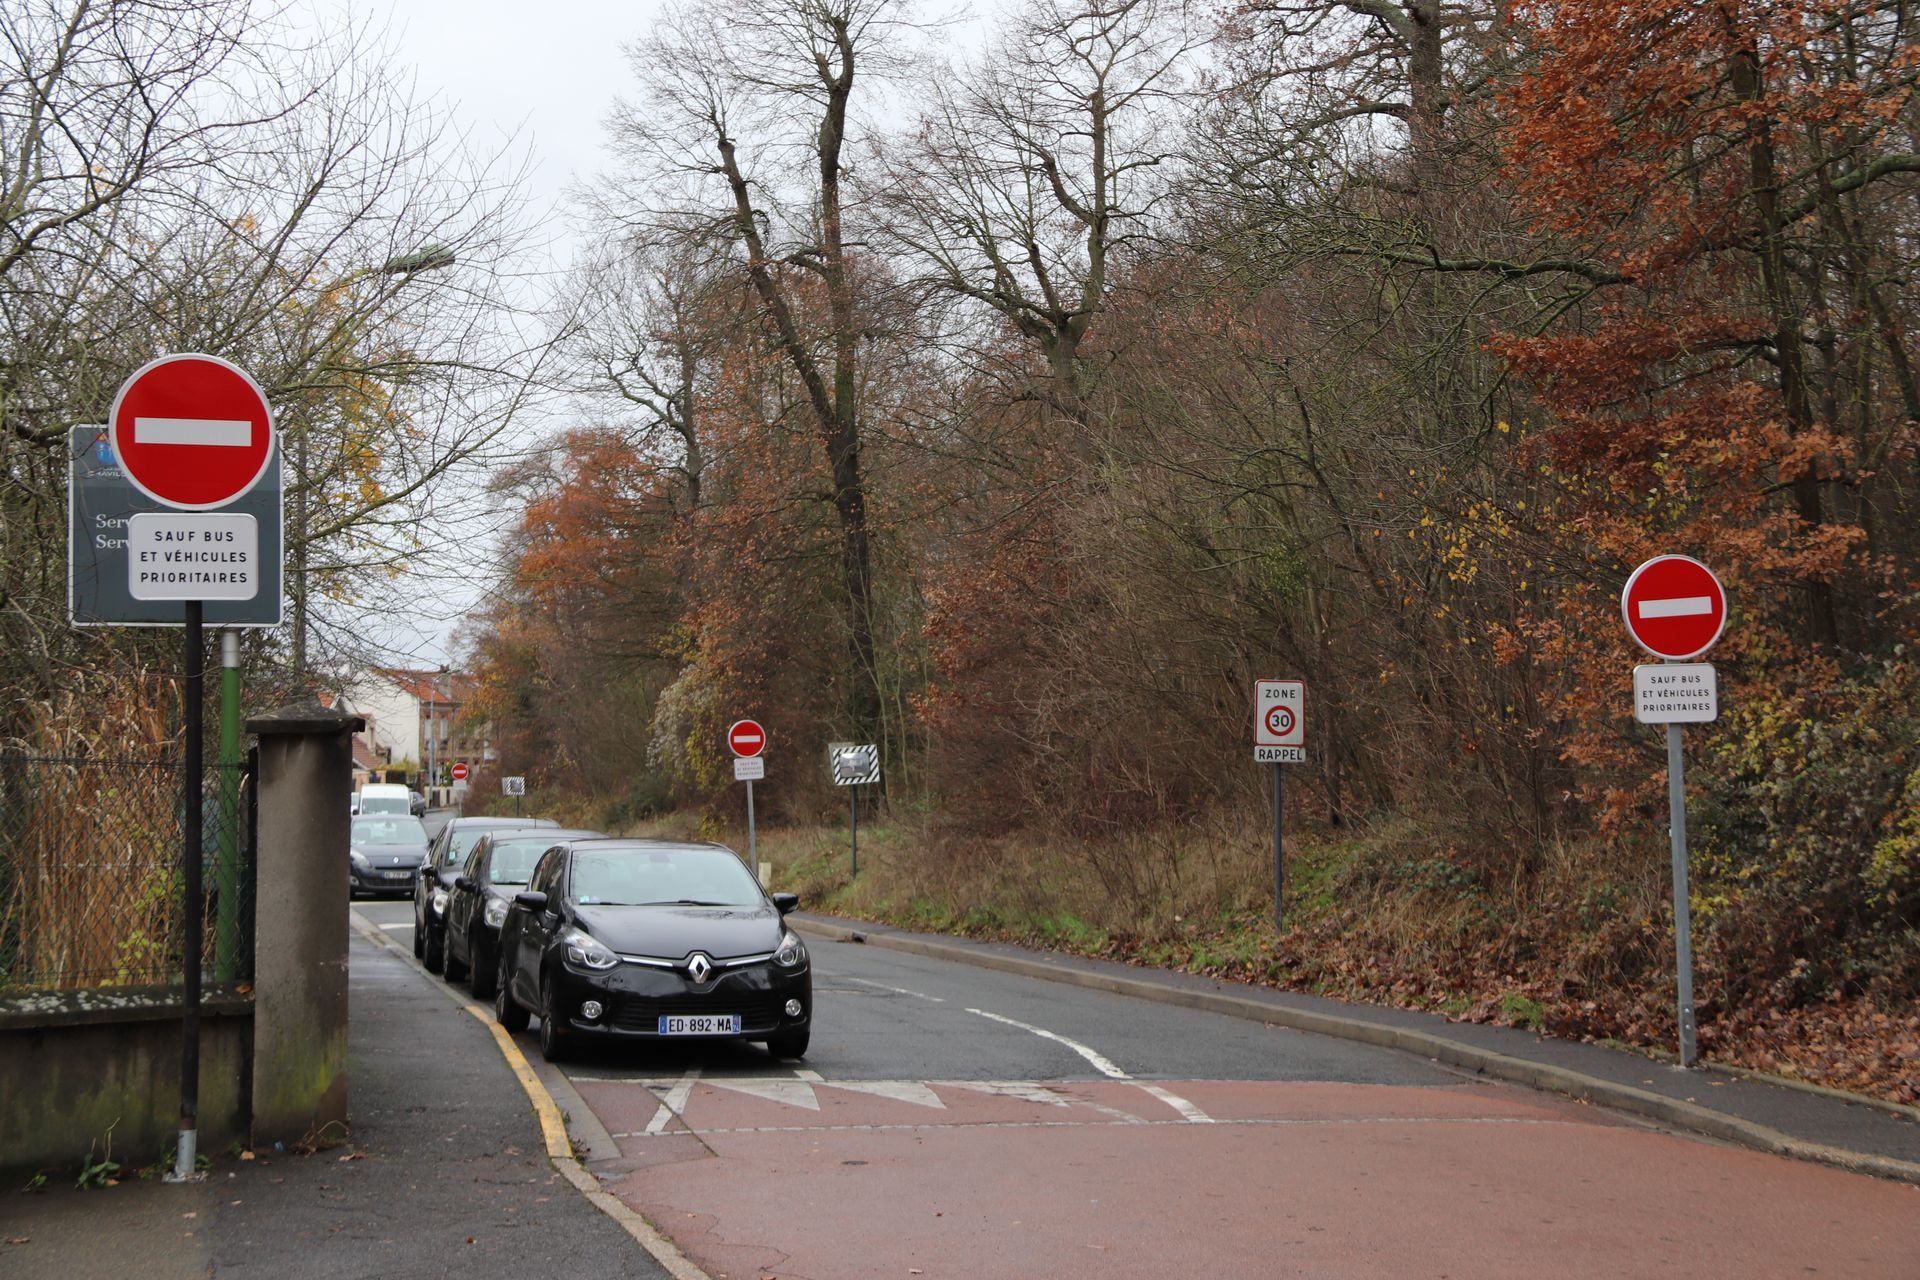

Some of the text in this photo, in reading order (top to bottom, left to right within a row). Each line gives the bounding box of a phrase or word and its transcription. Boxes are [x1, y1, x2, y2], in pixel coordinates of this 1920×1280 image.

[154, 531, 234, 542] SAUF BUS
[140, 549, 247, 563] ET VÉHICULES
[140, 572, 248, 583] PRIORITAIRES
[1651, 675, 1701, 684] SAUF BUS
[1265, 689, 1296, 699] ZONE
[1642, 688, 1710, 698] ET VÉHICULES
[1643, 702, 1711, 712] PRIORITAIRES
[1271, 714, 1290, 728] 30
[1258, 749, 1303, 760] RAPPEL
